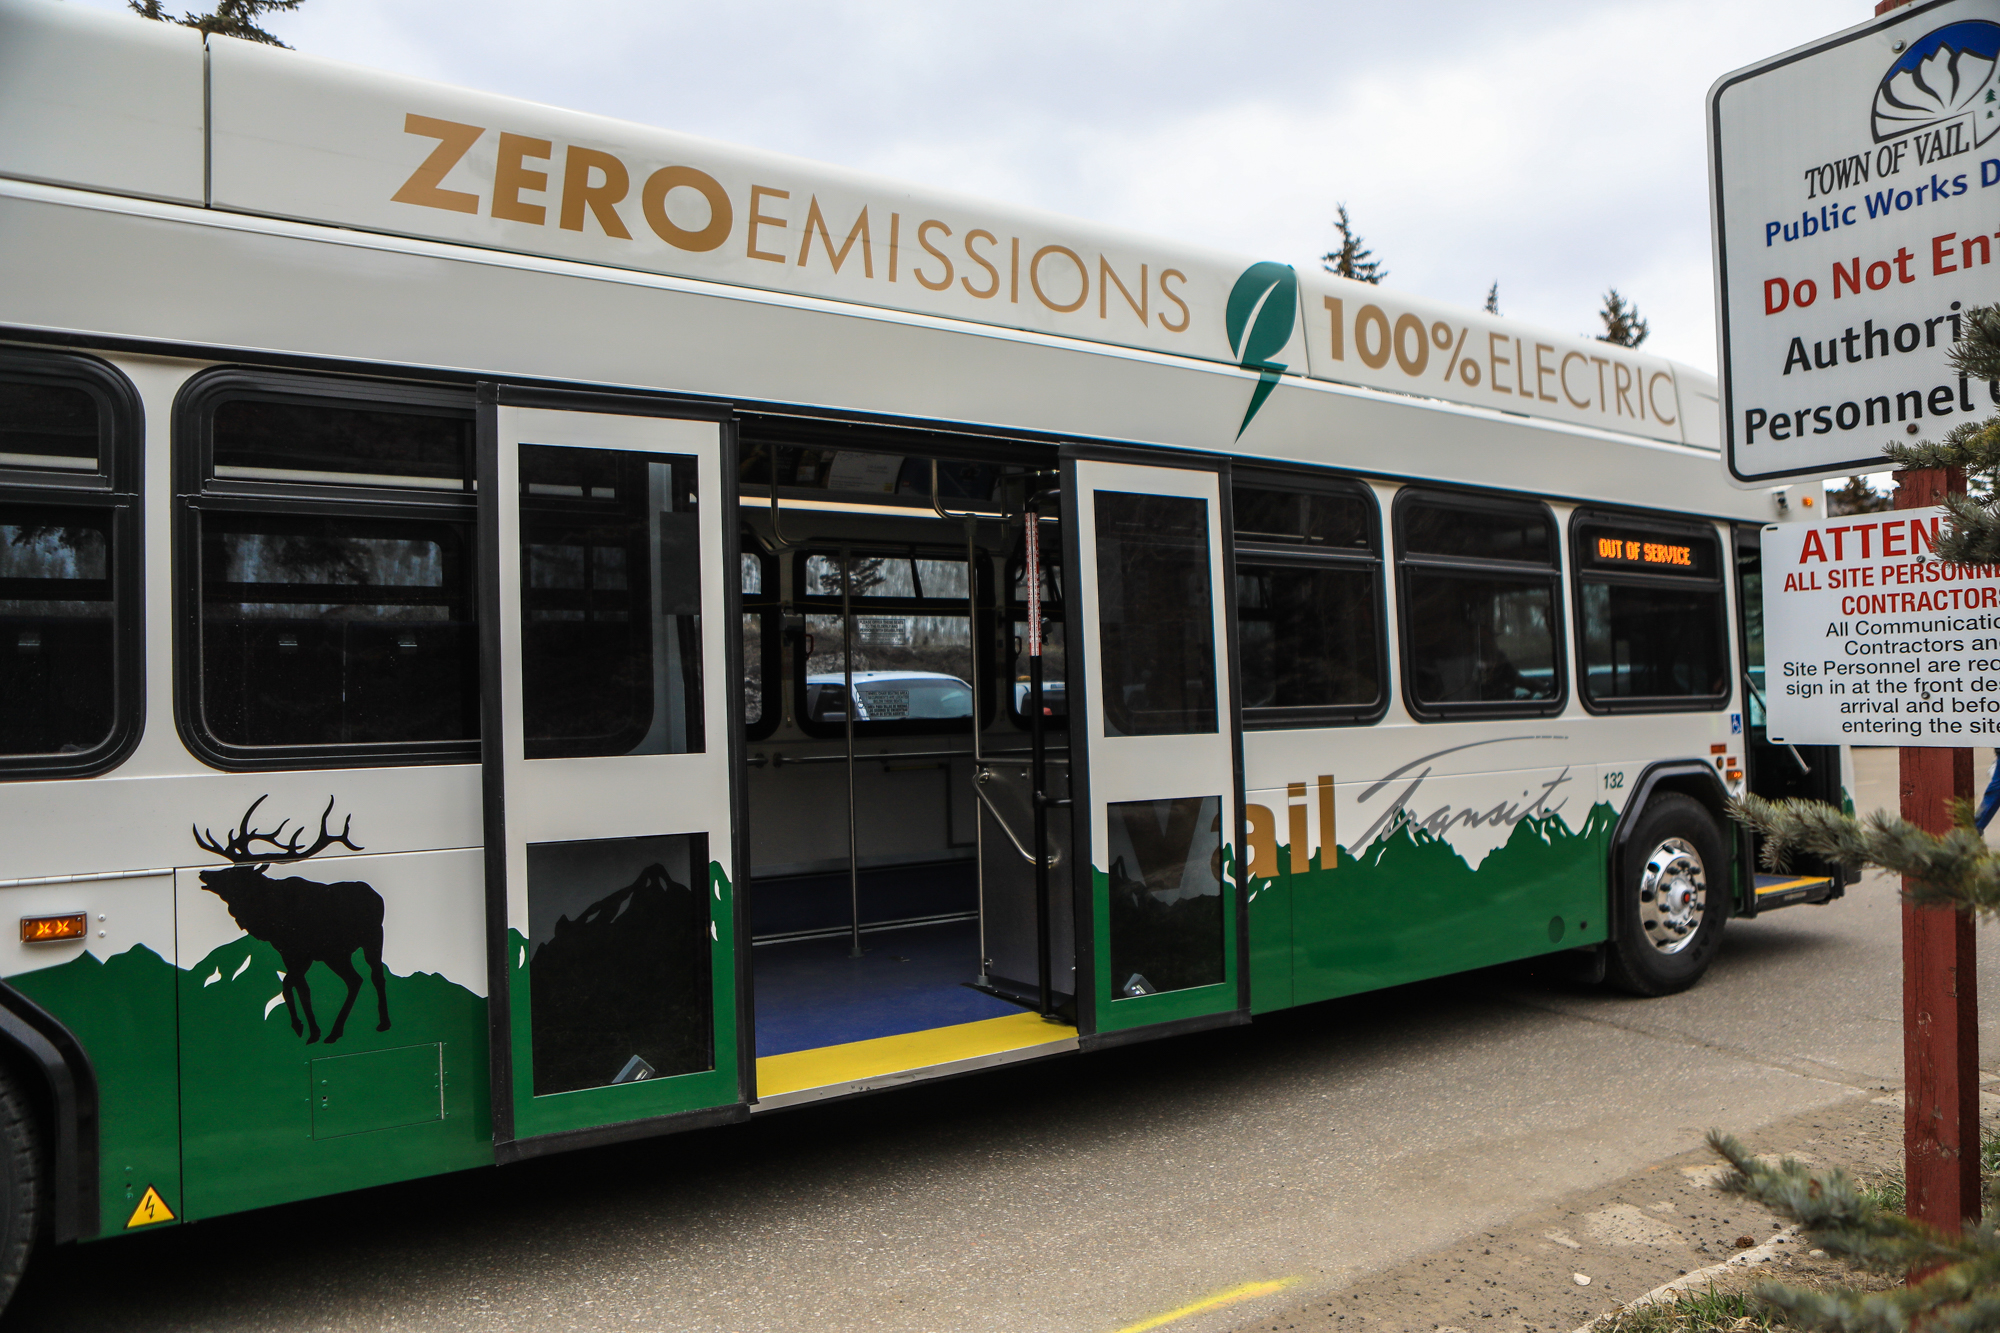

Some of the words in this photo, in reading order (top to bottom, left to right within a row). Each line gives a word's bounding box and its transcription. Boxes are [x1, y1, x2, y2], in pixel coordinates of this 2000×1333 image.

[1804, 150, 1871, 199] TOWN
[1876, 140, 1908, 178] OF
[1914, 121, 1970, 166] VAIL
[1765, 203, 1856, 247] Public
[1864, 173, 1968, 219] Works
[1763, 276, 1817, 316] Do
[1832, 247, 1916, 300] Not
[1783, 301, 1992, 375] Authori
[1745, 371, 1975, 445] Personnel
[1599, 538, 1623, 559] OUT
[1625, 541, 1641, 560] OF
[1643, 543, 1691, 565] SERVICE
[1799, 516, 1962, 564] ATTEN
[1784, 571, 1822, 593] ALL
[1828, 566, 1875, 589] SITE
[1842, 587, 2000, 616] CONTRACTOR
[1825, 621, 1849, 637] All
[1844, 637, 1964, 656] Contractors
[1971, 637, 2000, 651] an
[1783, 661, 1818, 677] Site
[1824, 657, 1920, 675] Personnel
[1927, 659, 1961, 673] are
[1786, 680, 1823, 699] sign
[1829, 679, 1846, 695] in
[1852, 679, 1871, 694] at
[1876, 678, 1908, 693] the
[1913, 677, 1964, 693] front
[1970, 676, 2000, 692] de
[1840, 698, 1899, 714] arrival
[1906, 697, 1944, 713] and
[1952, 696, 2000, 713] befo
[1842, 717, 1922, 737] entering
[1928, 717, 1963, 733] the
[1603, 771, 1625, 790] 132
[1345, 733, 1573, 856] Transit
